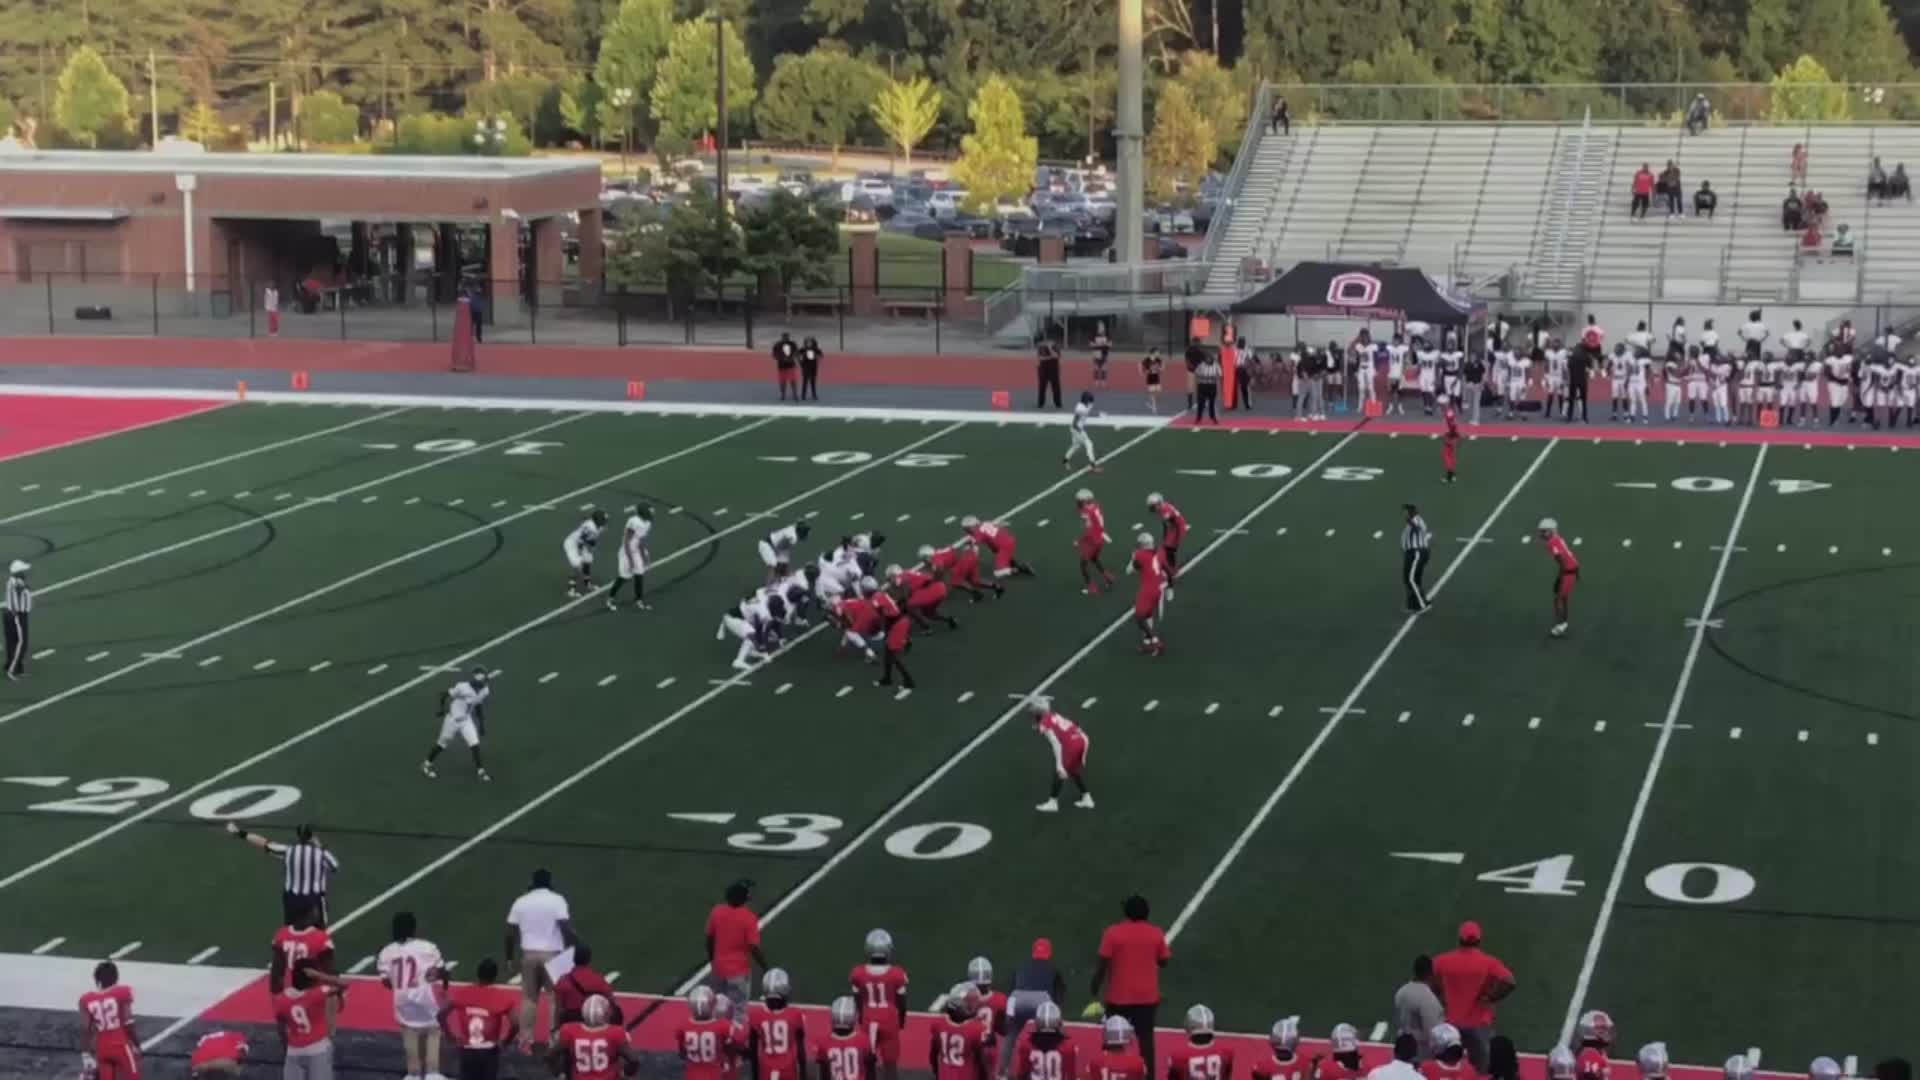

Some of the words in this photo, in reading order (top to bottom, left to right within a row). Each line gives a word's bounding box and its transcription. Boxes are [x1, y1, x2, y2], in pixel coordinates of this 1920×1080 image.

[866, 982, 889, 1009] 11
[88, 998, 121, 1033] 32
[290, 1004, 311, 1034] 9
[684, 1030, 717, 1063] 28
[761, 1020, 788, 1055] 19
[939, 1031, 966, 1066] 12
[574, 1038, 610, 1073] 56
[827, 1047, 860, 1080] 20
[1029, 1050, 1063, 1080] 30
